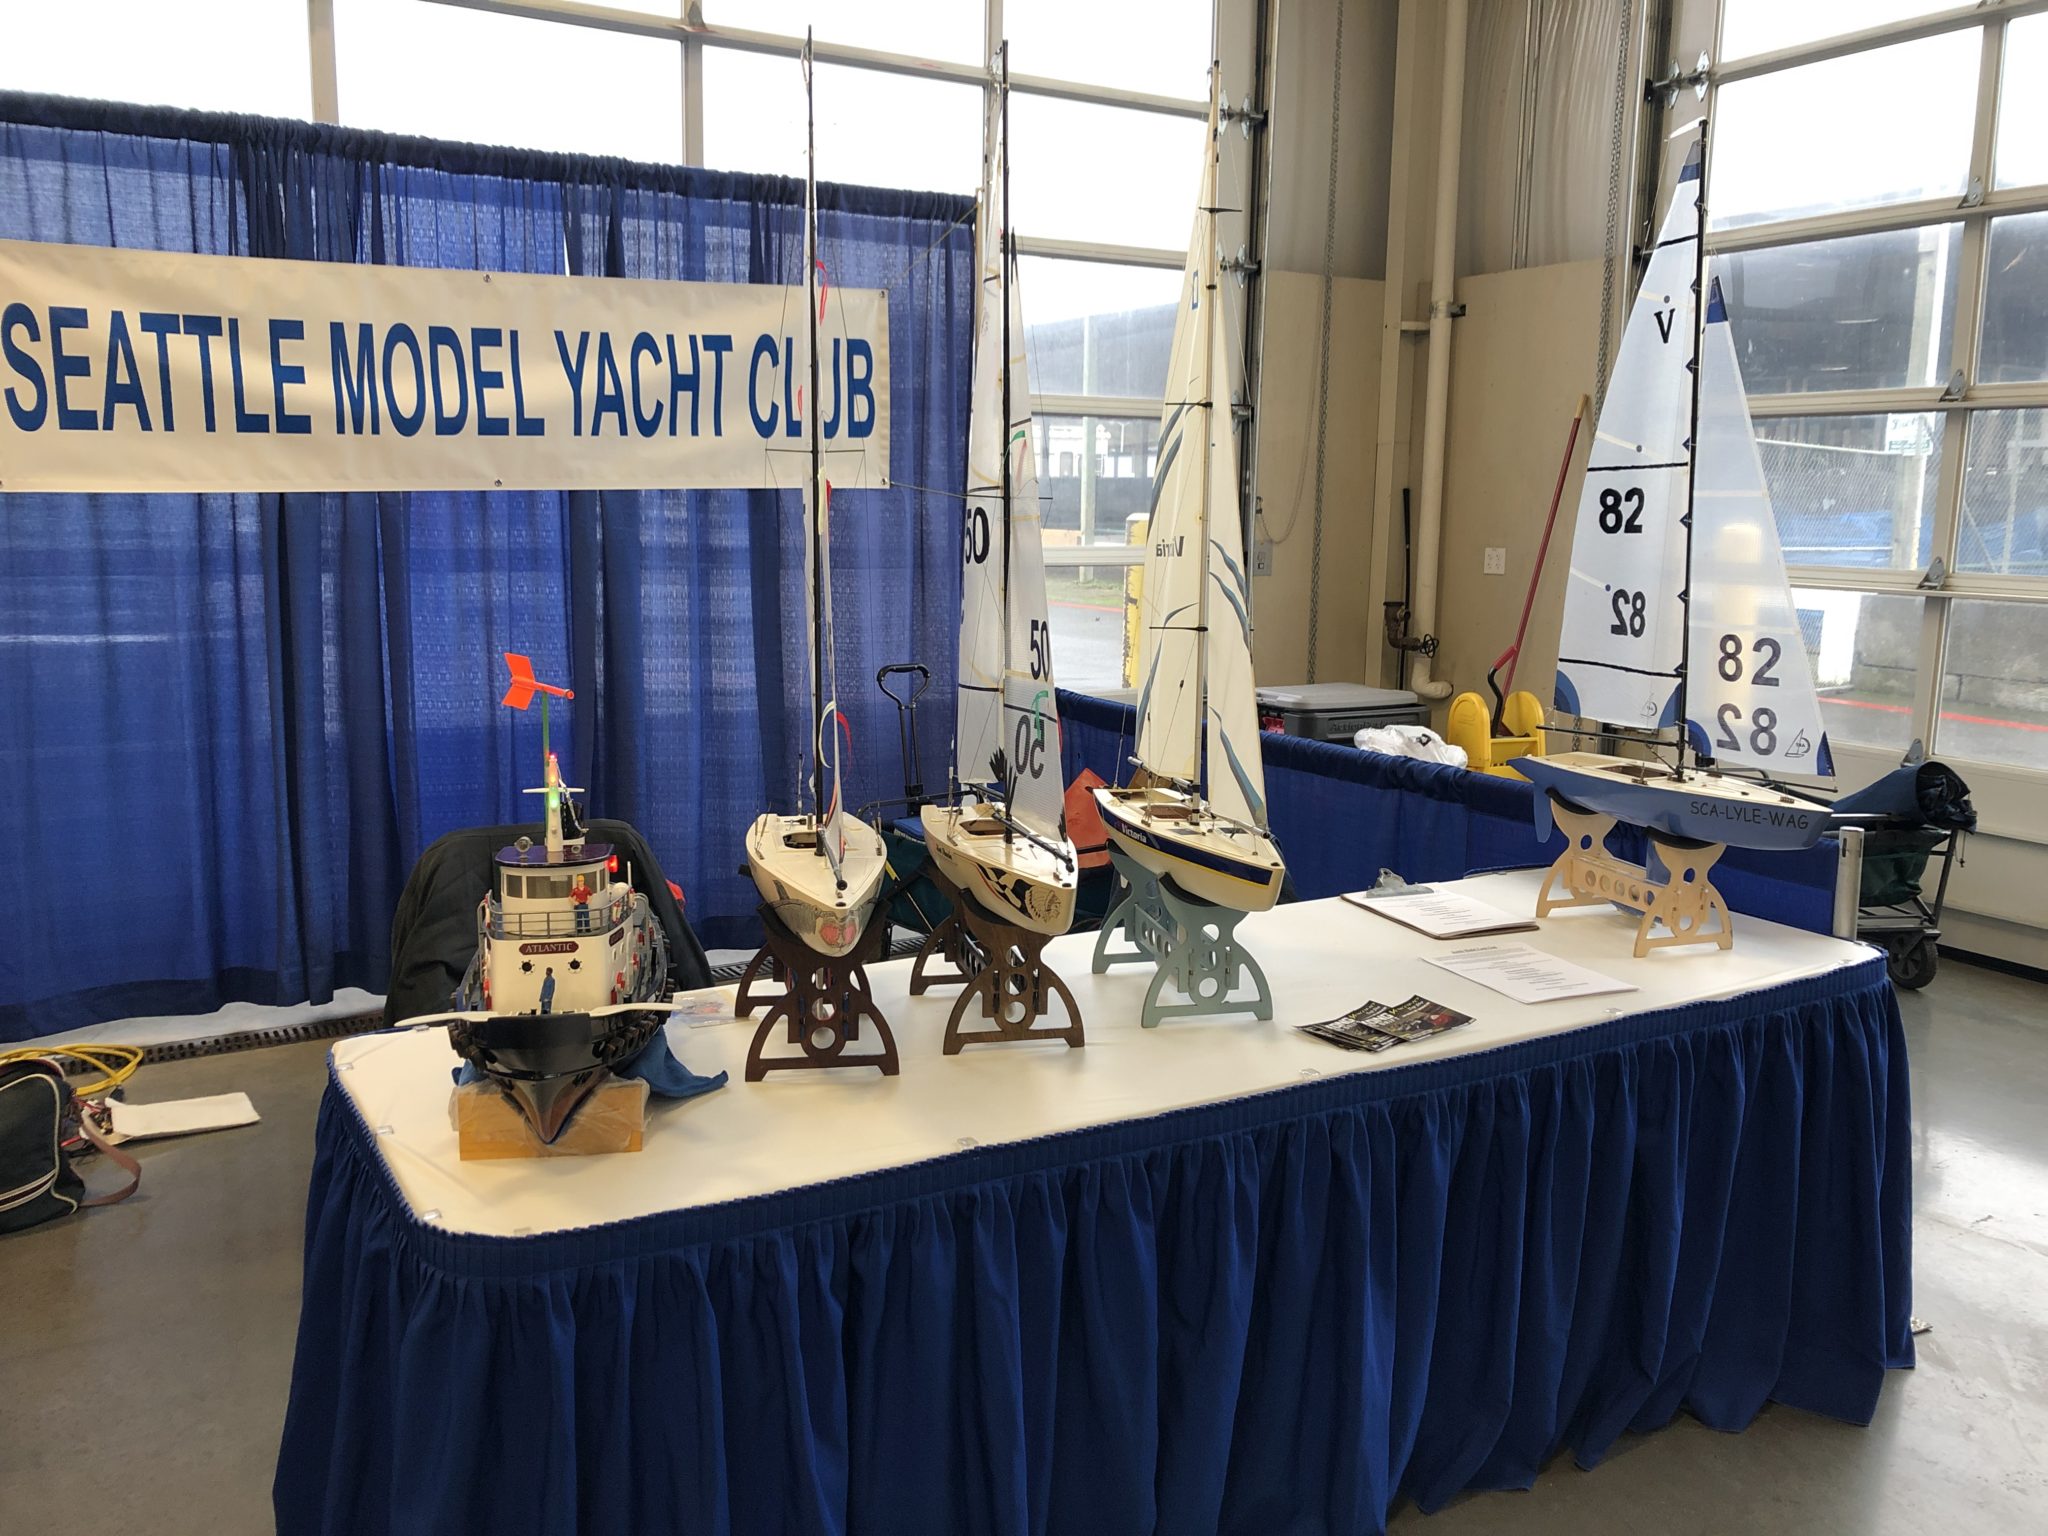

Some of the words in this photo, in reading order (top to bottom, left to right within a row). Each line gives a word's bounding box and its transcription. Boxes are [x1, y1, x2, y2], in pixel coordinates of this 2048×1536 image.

[1654, 308, 1675, 343] V
[1, 302, 312, 432] SEATTLE
[330, 322, 545, 437] MODEL
[554, 330, 733, 438] YACHT
[1599, 487, 1645, 534] 82
[964, 507, 989, 564] 50
[1030, 620, 1050, 682] 50
[1718, 634, 1782, 687] 82
[1121, 822, 1147, 843] Victoria
[1689, 800, 1809, 830] SCA-LYLE-WAG
[525, 943, 573, 953] ATLANTIC
